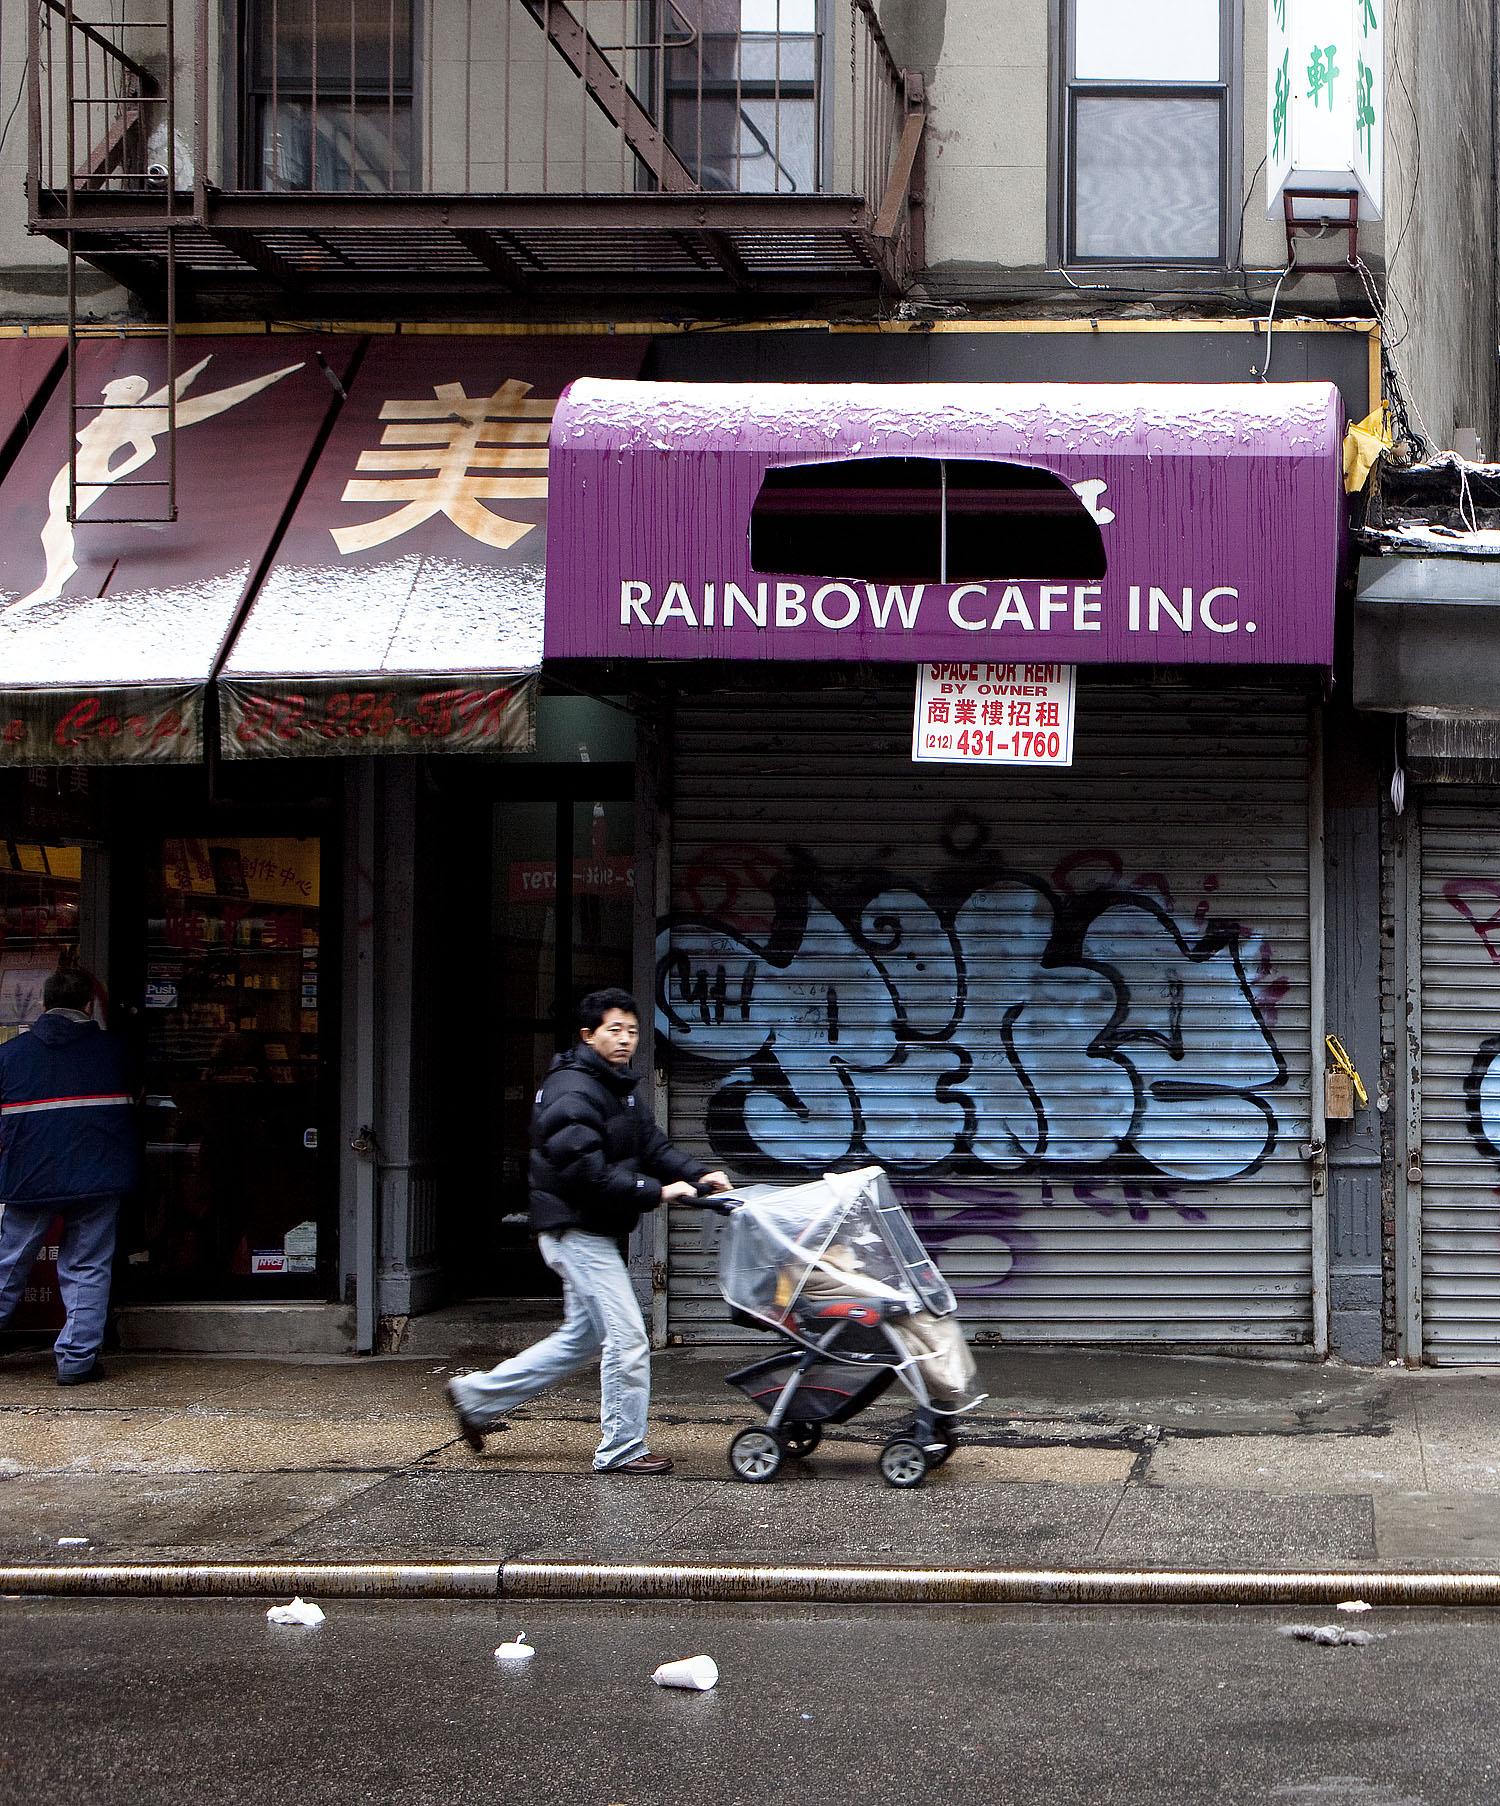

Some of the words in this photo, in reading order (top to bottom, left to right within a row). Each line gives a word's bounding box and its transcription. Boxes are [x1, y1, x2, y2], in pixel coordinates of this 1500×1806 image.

[329, 378, 550, 555] 美
[620, 580, 926, 630] RAINBOW
[948, 584, 1102, 631] CAFE
[1128, 585, 1257, 634] INC.
[930, 663, 979, 682] SPACE
[986, 663, 1017, 682] FOR
[1023, 664, 1062, 684] RENT
[940, 683, 968, 695] BY
[977, 684, 1048, 697] OWNER
[55, 697, 190, 749] Corp.
[237, 687, 514, 742] 212-226-5898
[927, 697, 1061, 727] 商業樓招租
[926, 734, 953, 750] (212)
[957, 729, 1061, 757] 431-1760
[147, 983, 177, 996] Push
[257, 1257, 286, 1267] NYCE
